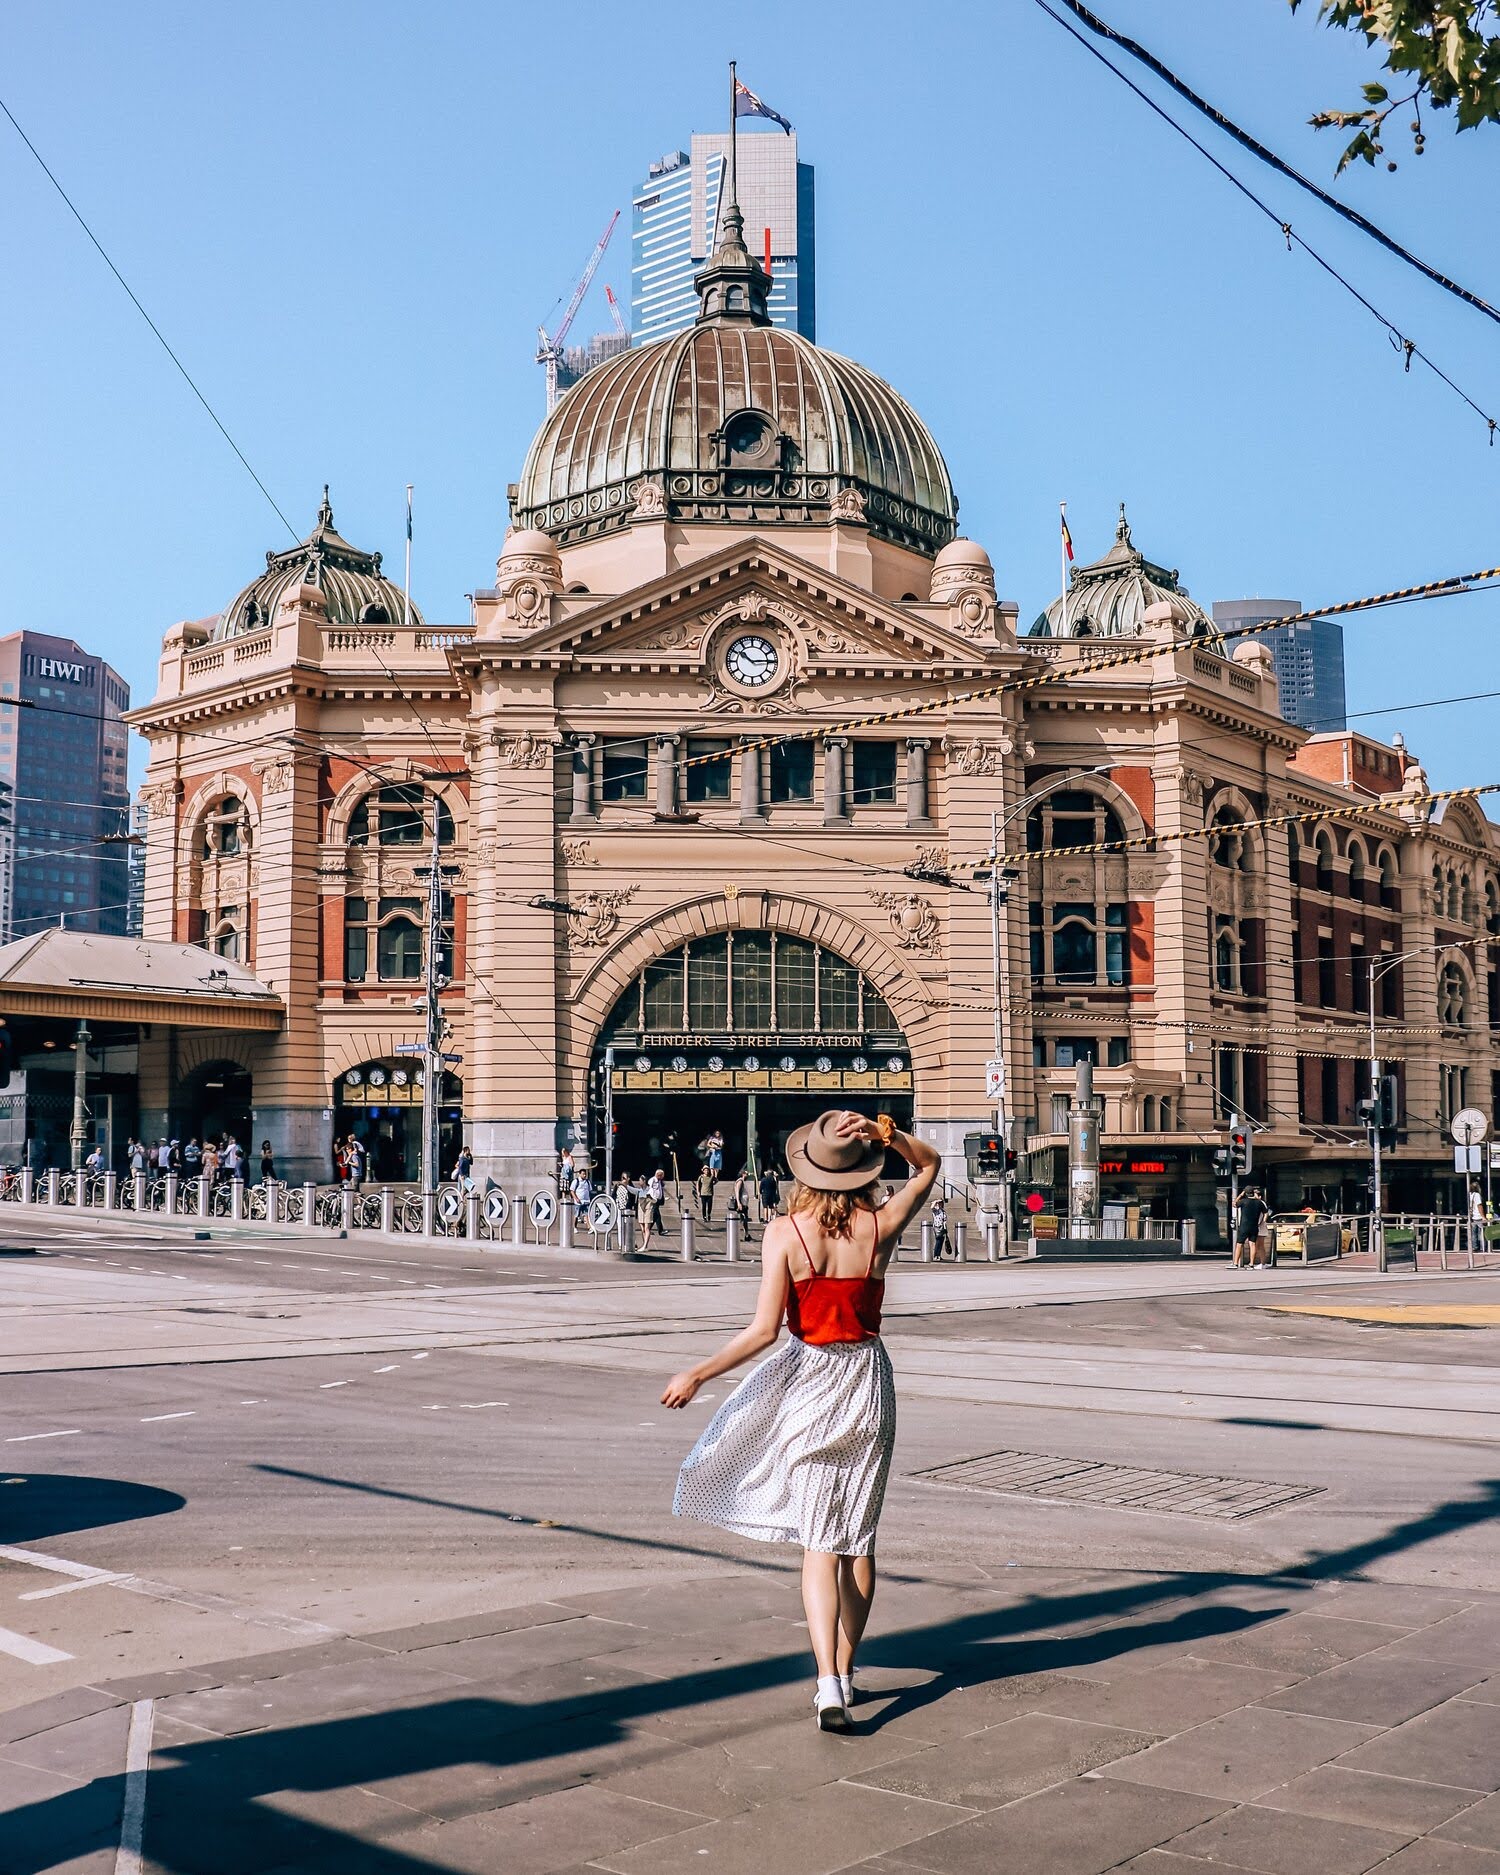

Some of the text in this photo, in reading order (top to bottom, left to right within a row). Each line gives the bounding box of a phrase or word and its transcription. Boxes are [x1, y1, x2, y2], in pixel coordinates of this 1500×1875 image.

[40, 657, 85, 682] HWT
[642, 1035, 862, 1047] FLINDERS STREET STATION
